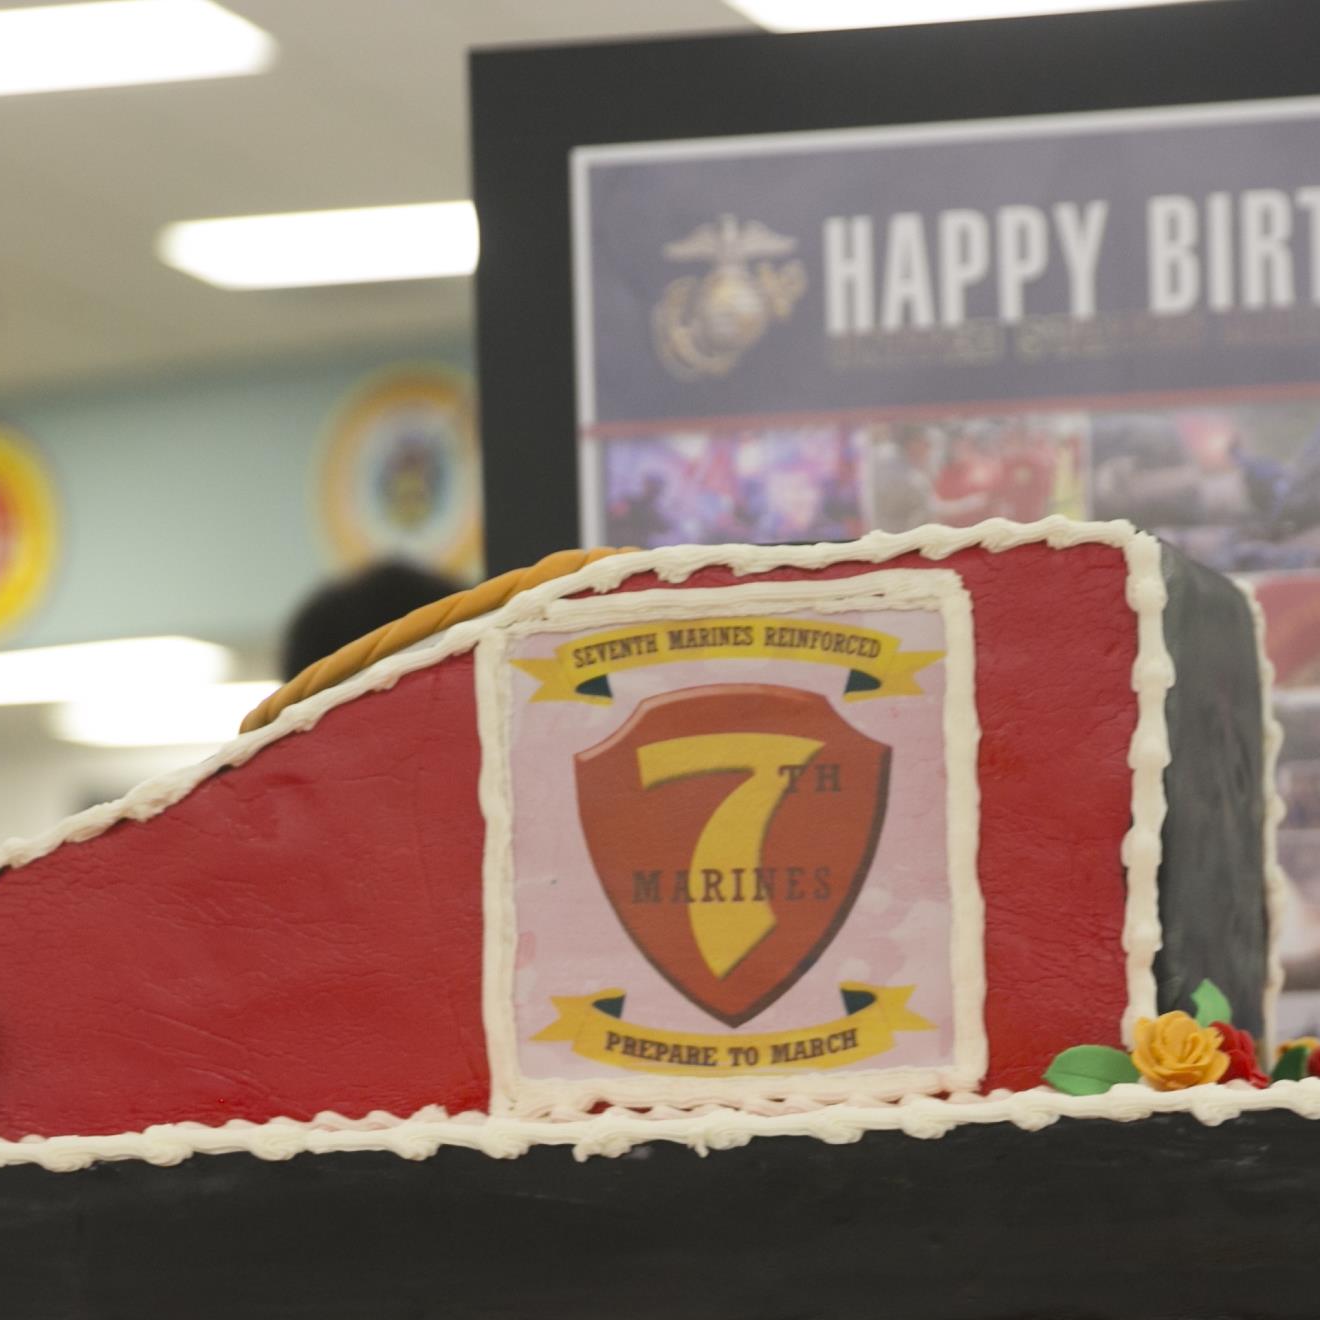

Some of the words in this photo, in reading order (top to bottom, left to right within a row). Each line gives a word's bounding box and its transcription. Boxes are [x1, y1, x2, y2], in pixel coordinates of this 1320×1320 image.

[823, 199, 1110, 338] HAPPY
[572, 632, 658, 669] SEVENTH
[666, 625, 754, 650] MARINES
[763, 626, 881, 660] REINFORCED
[631, 865, 833, 906] MARINES
[604, 1030, 718, 1068] PREPARE
[727, 1046, 760, 1068] TO
[770, 1027, 859, 1065] MARCH
